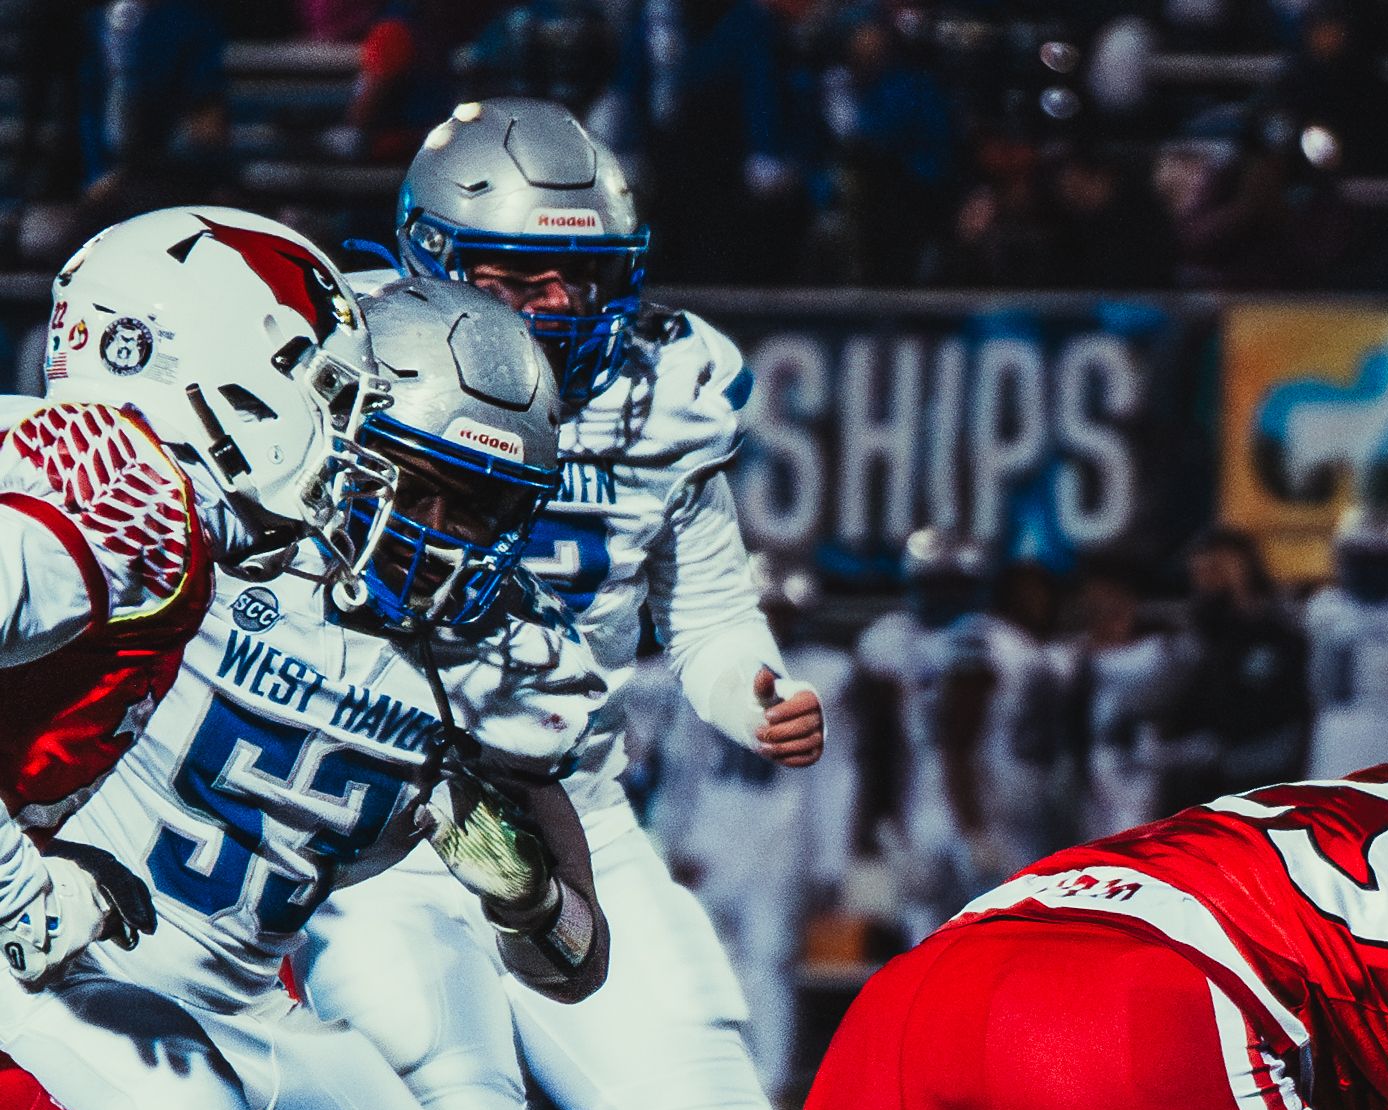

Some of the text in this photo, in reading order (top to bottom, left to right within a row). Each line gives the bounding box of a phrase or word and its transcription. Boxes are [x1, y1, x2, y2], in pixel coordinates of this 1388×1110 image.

[740, 334, 1140, 546] SHIPS
[234, 593, 279, 627] SCC
[216, 630, 328, 713] WEST
